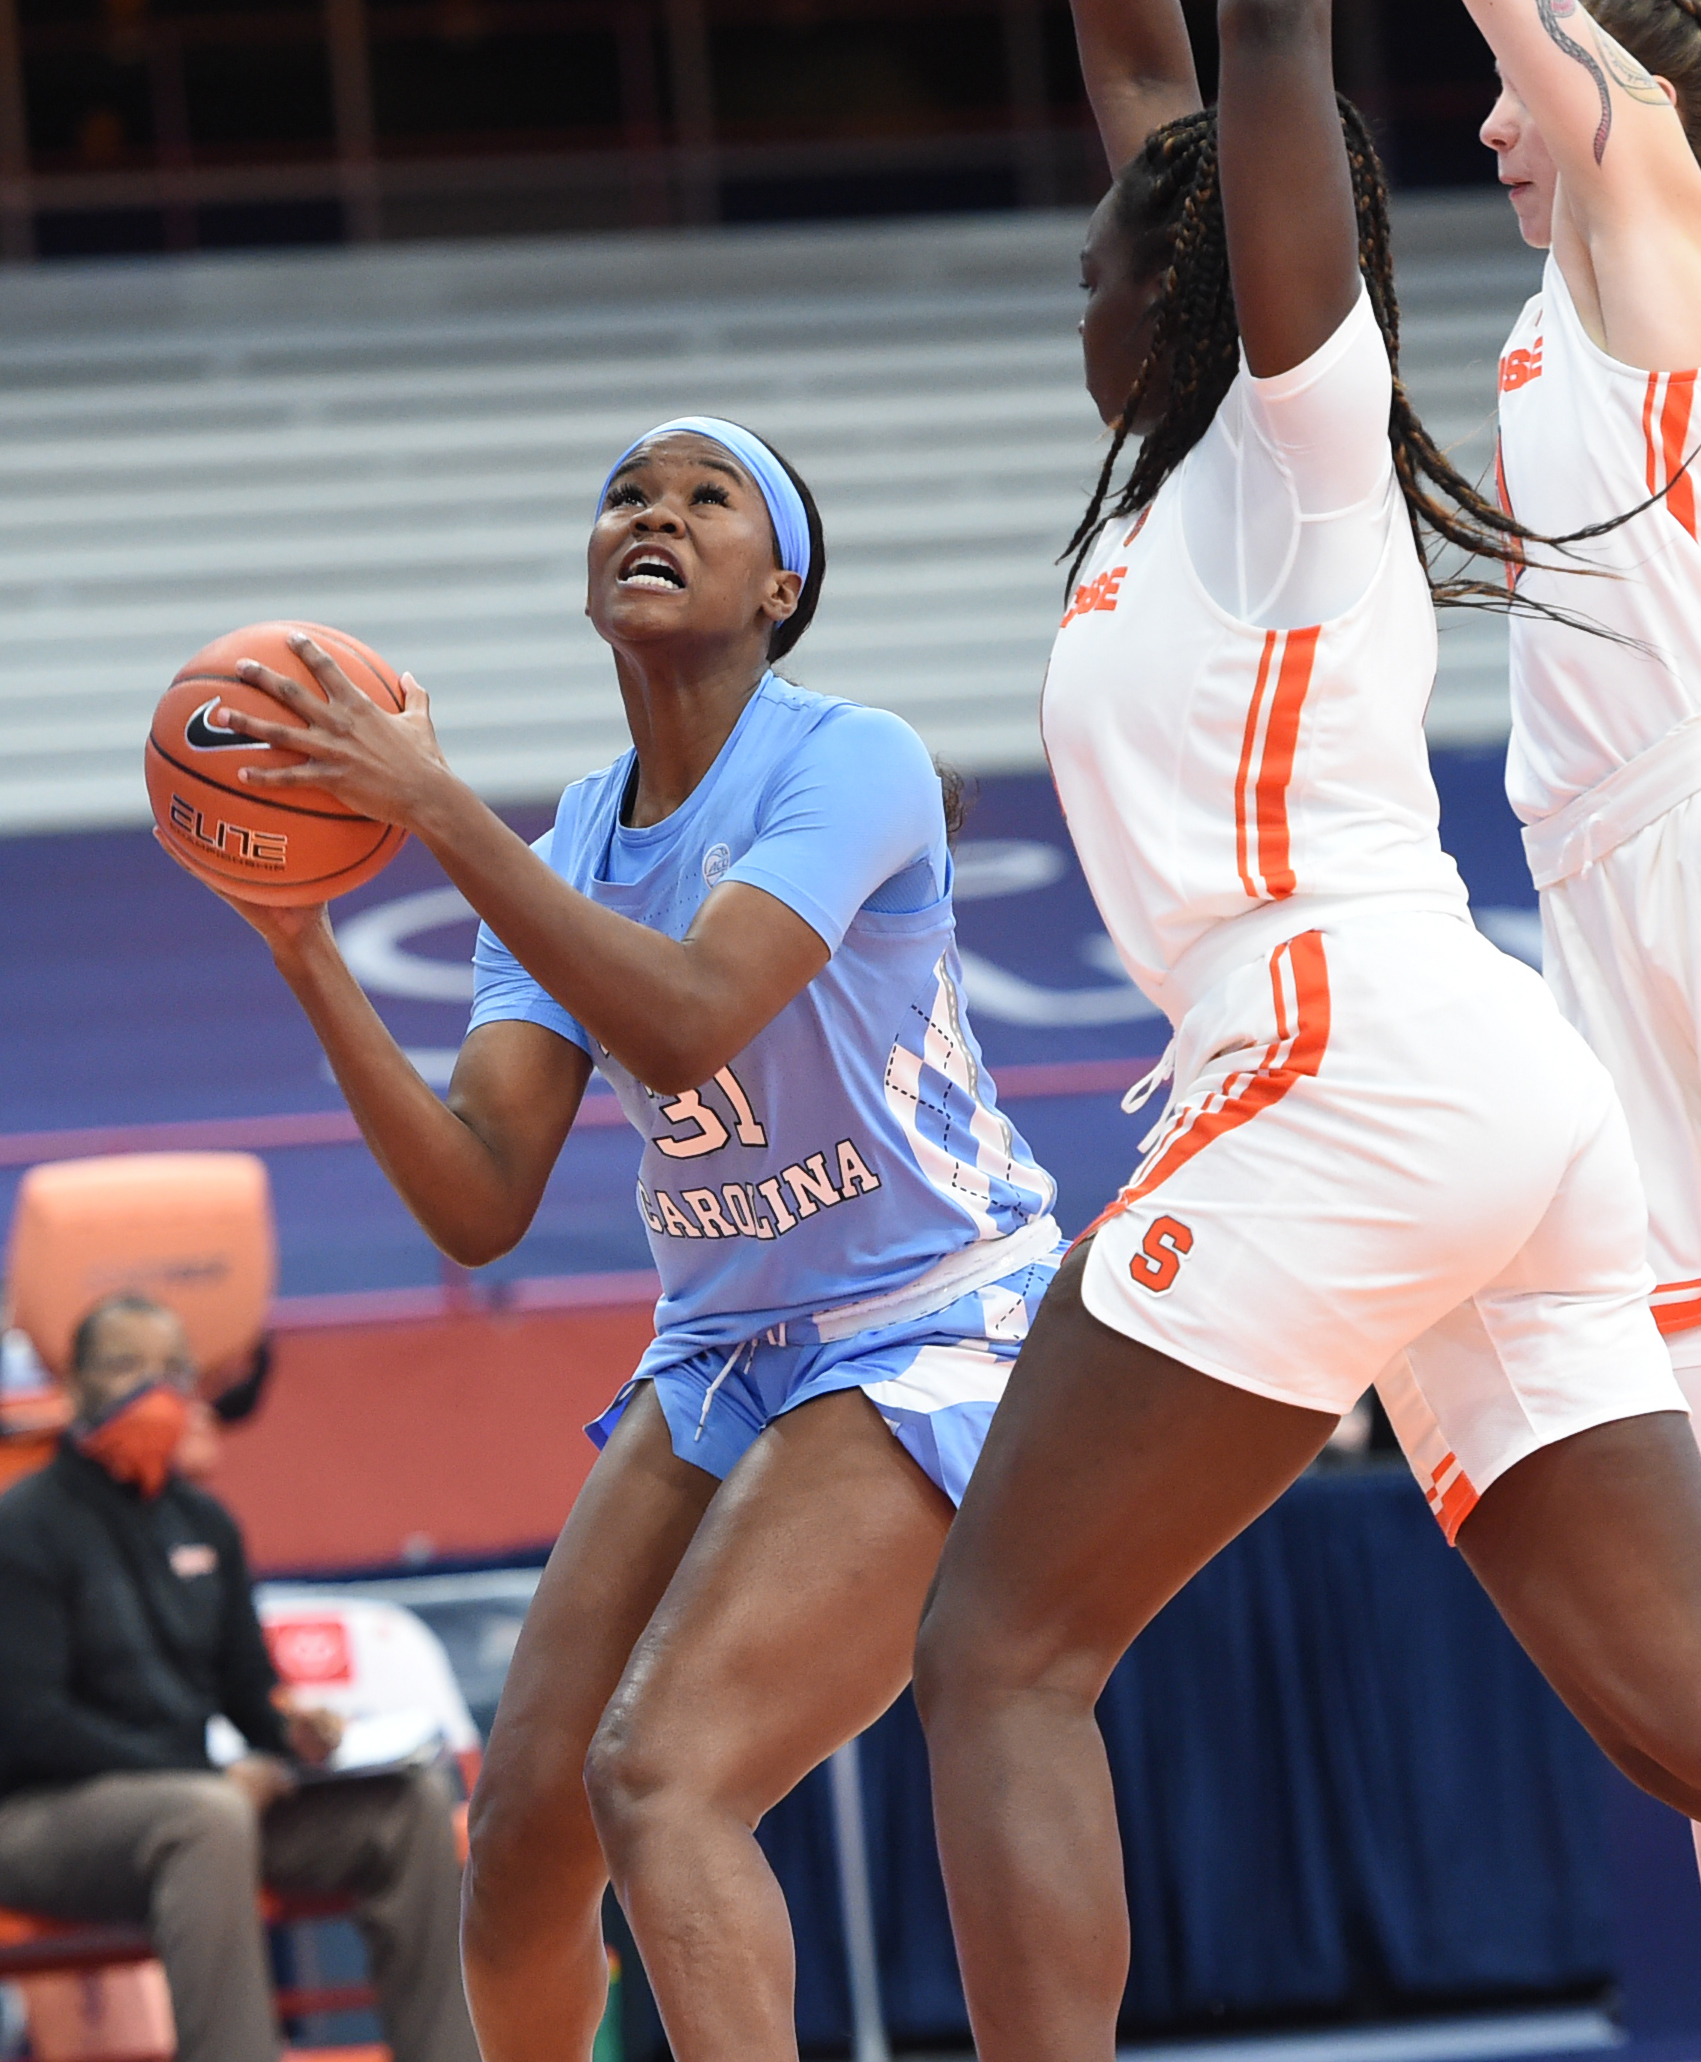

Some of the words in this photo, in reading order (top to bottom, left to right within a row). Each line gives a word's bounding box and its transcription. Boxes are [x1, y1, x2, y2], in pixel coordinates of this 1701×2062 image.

[169, 791, 288, 864] ELITE
[652, 1064, 768, 1160] 31
[637, 1137, 882, 1240] CAROLINA
[1128, 1214, 1194, 1293] S
